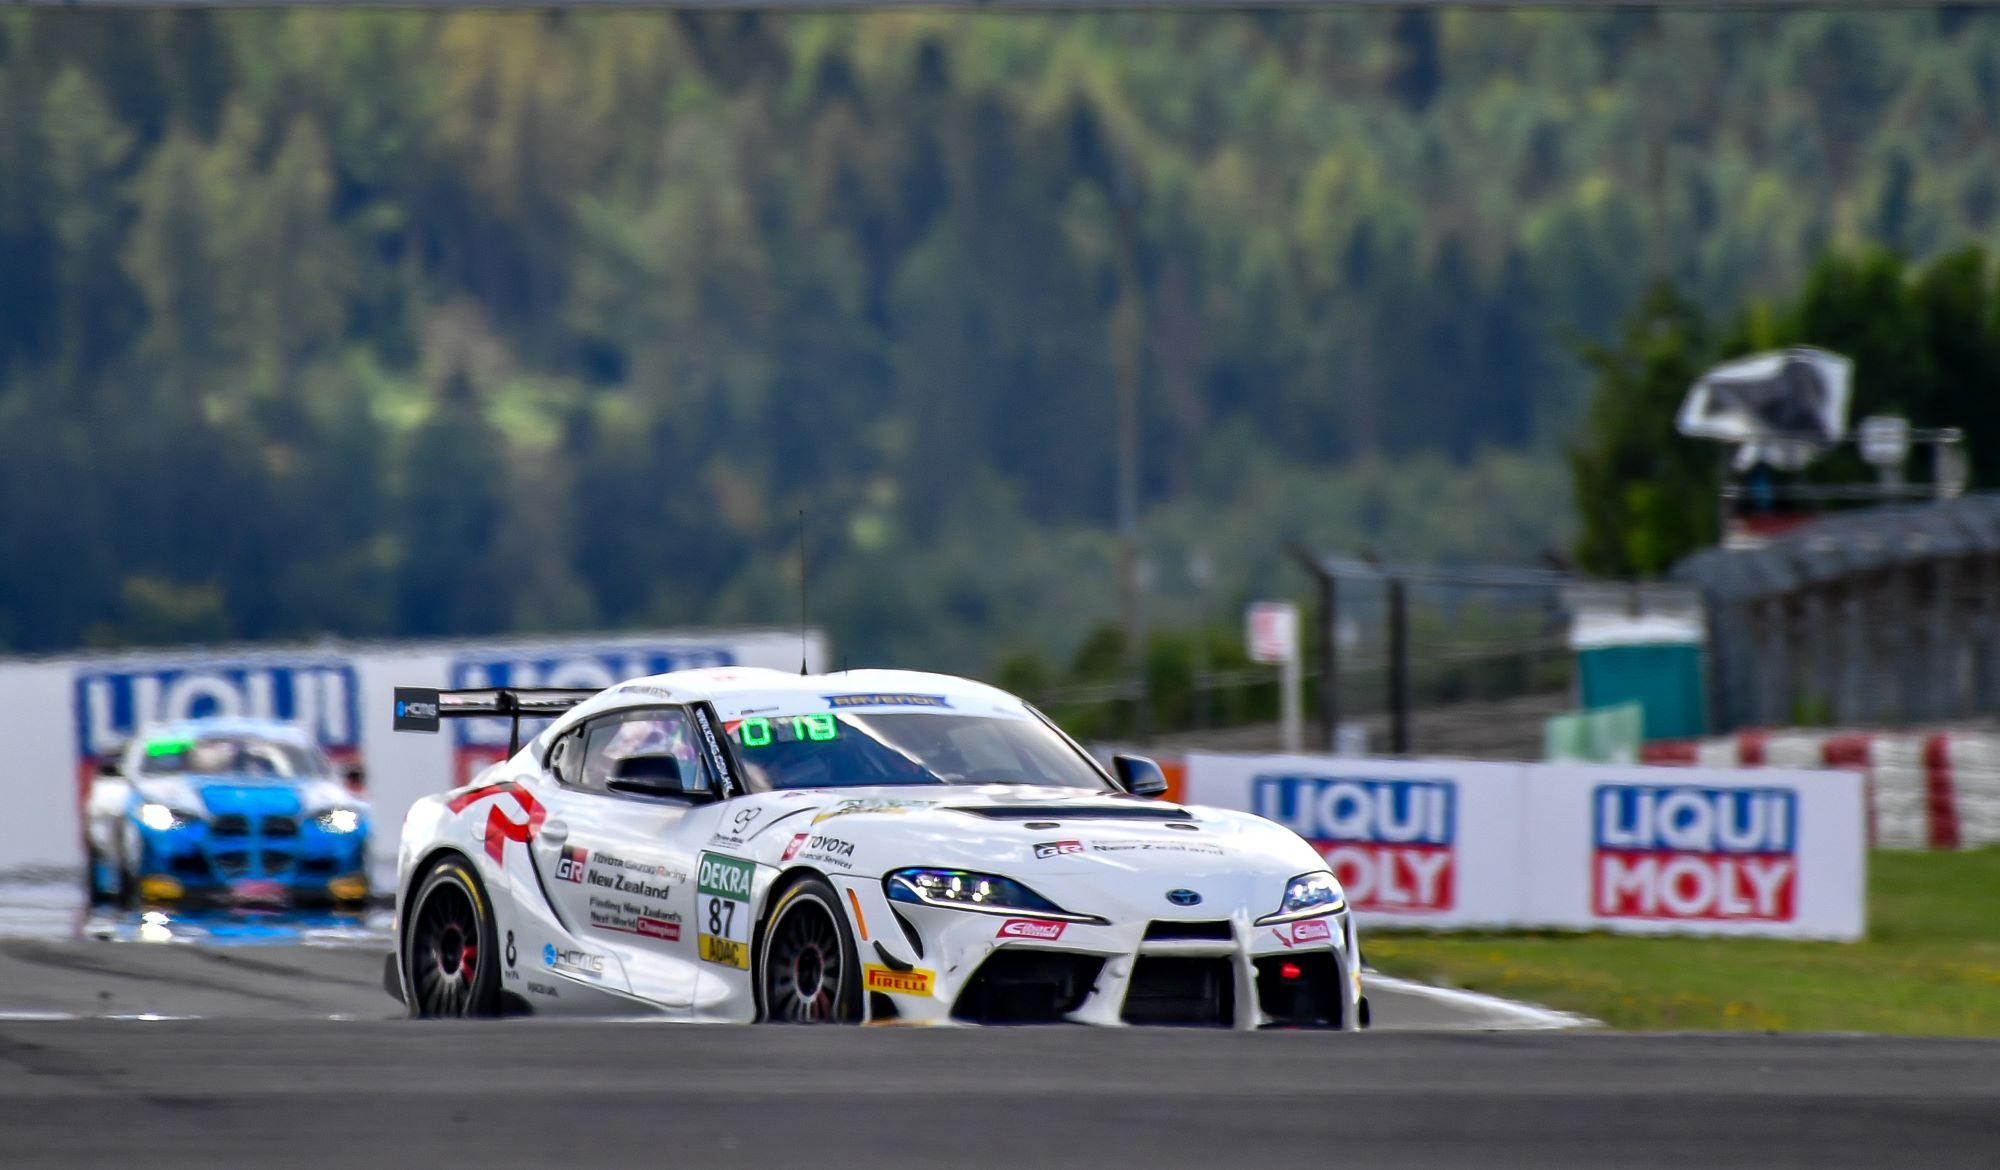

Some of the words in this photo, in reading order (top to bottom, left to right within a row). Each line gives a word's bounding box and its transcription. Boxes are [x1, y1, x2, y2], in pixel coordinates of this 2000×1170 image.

[1602, 791, 1789, 850] LIQUI
[593, 852, 624, 868] TOYOTA
[807, 836, 855, 857] TOYOTA
[556, 858, 585, 883] GR
[824, 855, 853, 870] Services
[1326, 846, 1449, 907] OLY
[587, 868, 613, 888] New
[614, 874, 670, 900] Zealand
[700, 860, 750, 896] DEKRA
[1602, 855, 1790, 916] MOLY
[708, 897, 735, 939] 87
[709, 937, 740, 966] ADAC
[868, 969, 928, 992] PIRELLI
